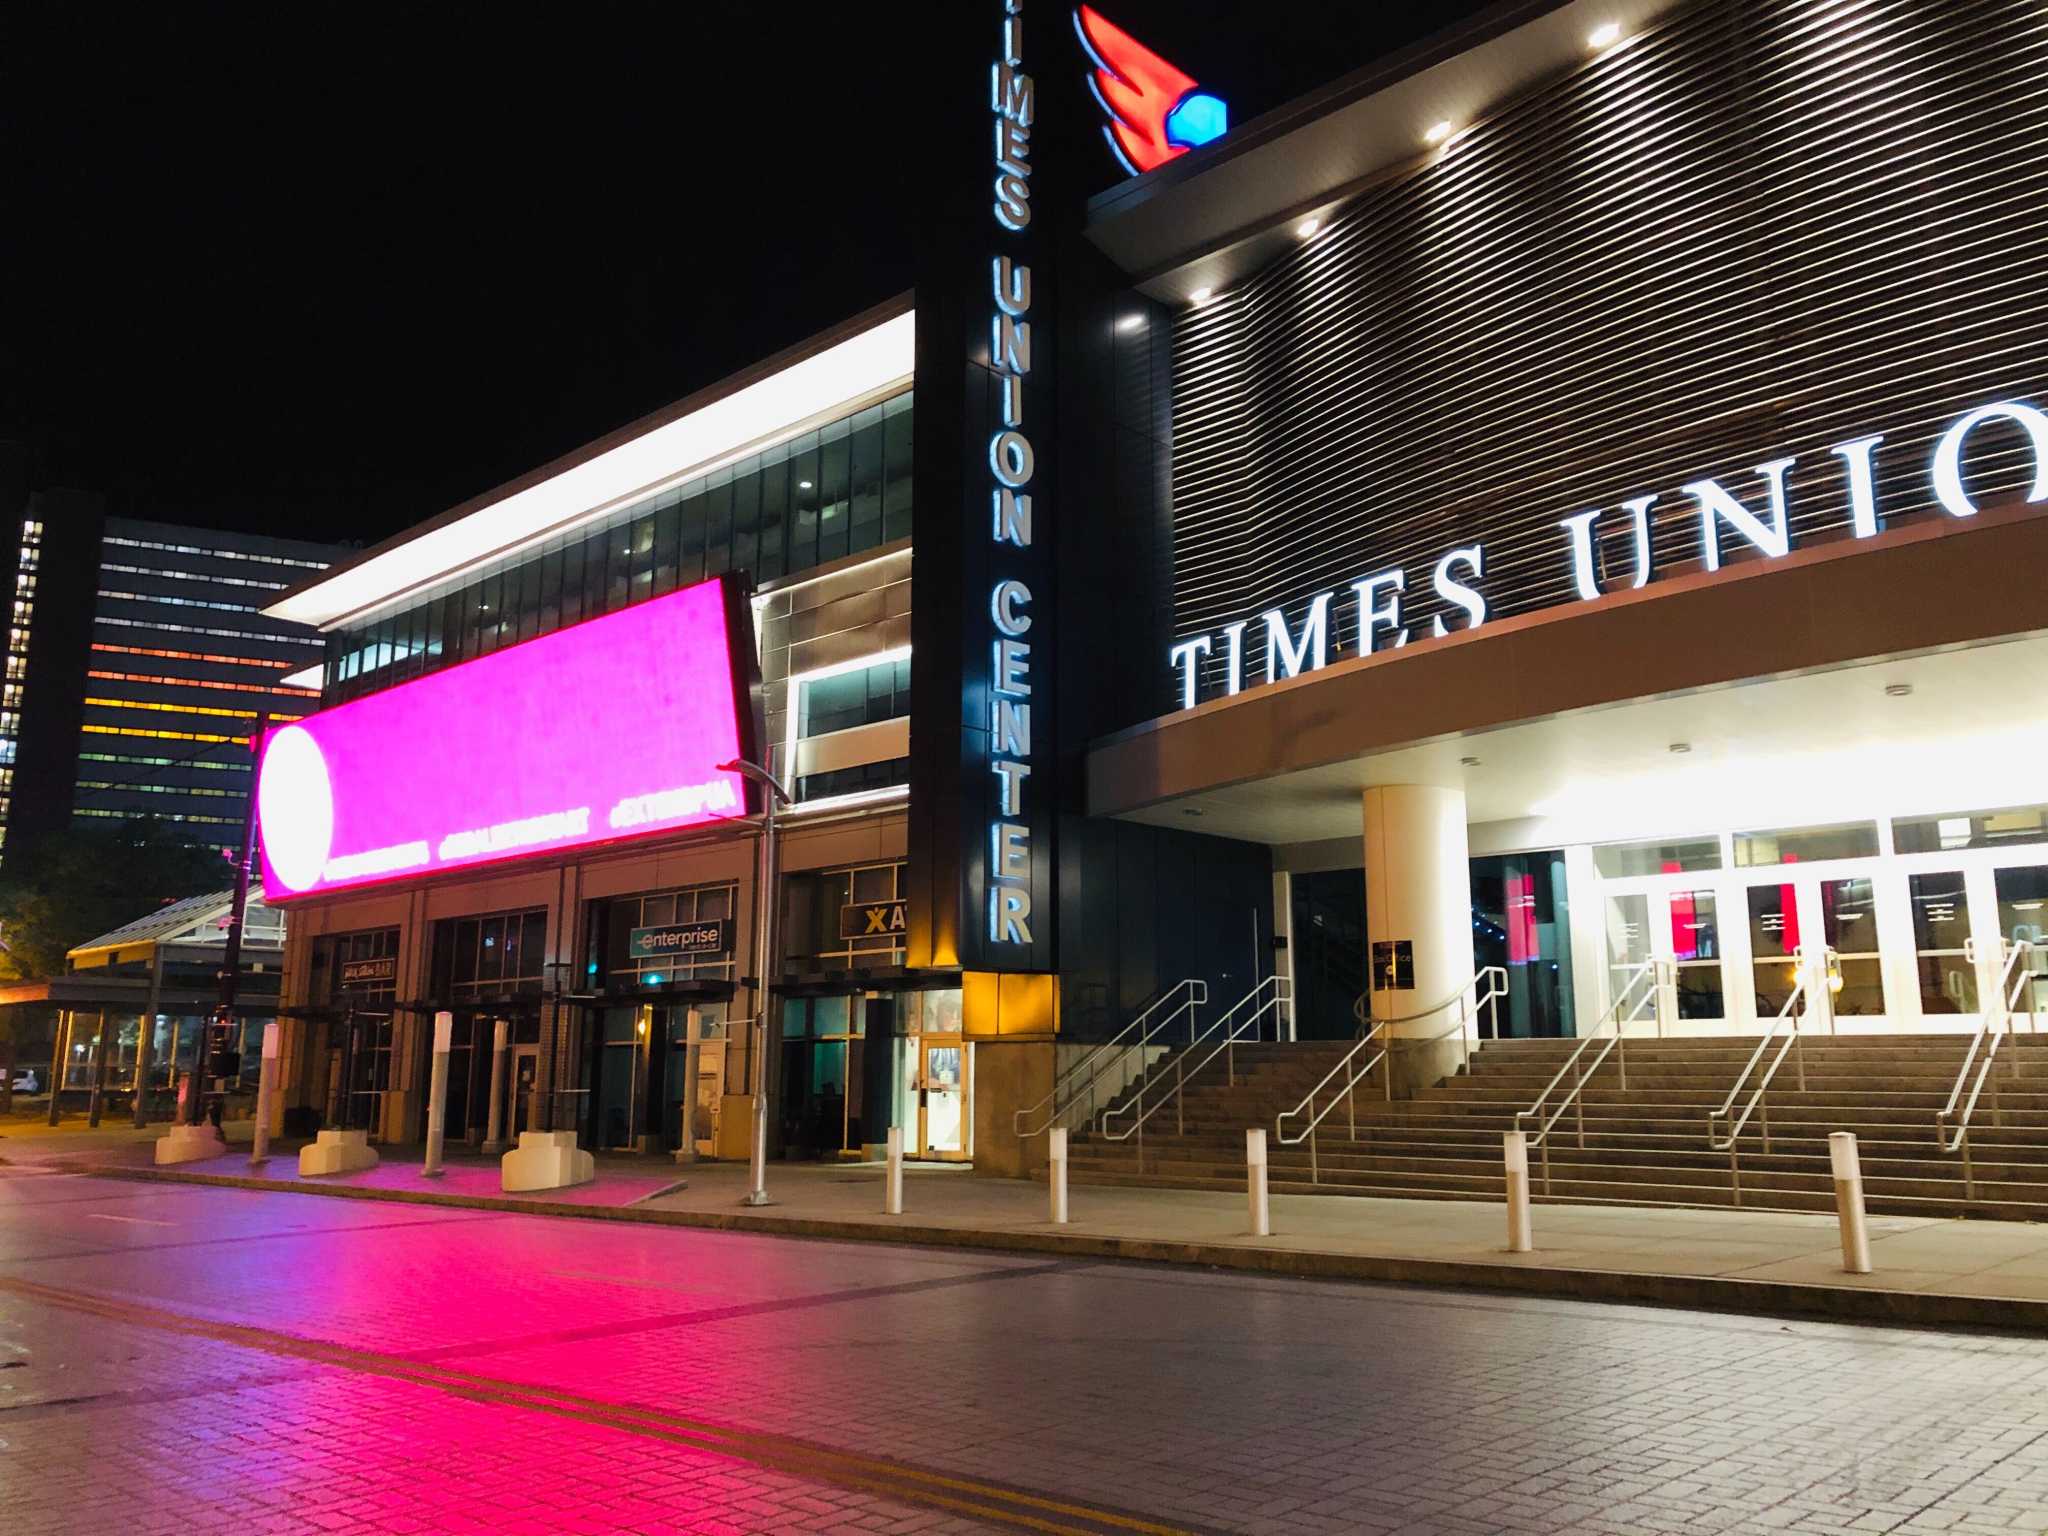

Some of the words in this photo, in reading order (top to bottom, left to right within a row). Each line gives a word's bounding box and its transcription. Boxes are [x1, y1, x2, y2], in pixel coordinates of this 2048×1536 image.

[991, 0, 1034, 231] IMES
[990, 255, 1035, 546] UNION
[1170, 544, 1487, 710] TIMES
[1560, 402, 2048, 601] UNIO
[989, 580, 1034, 945] CENTER
[638, 926, 718, 949] enterprise
